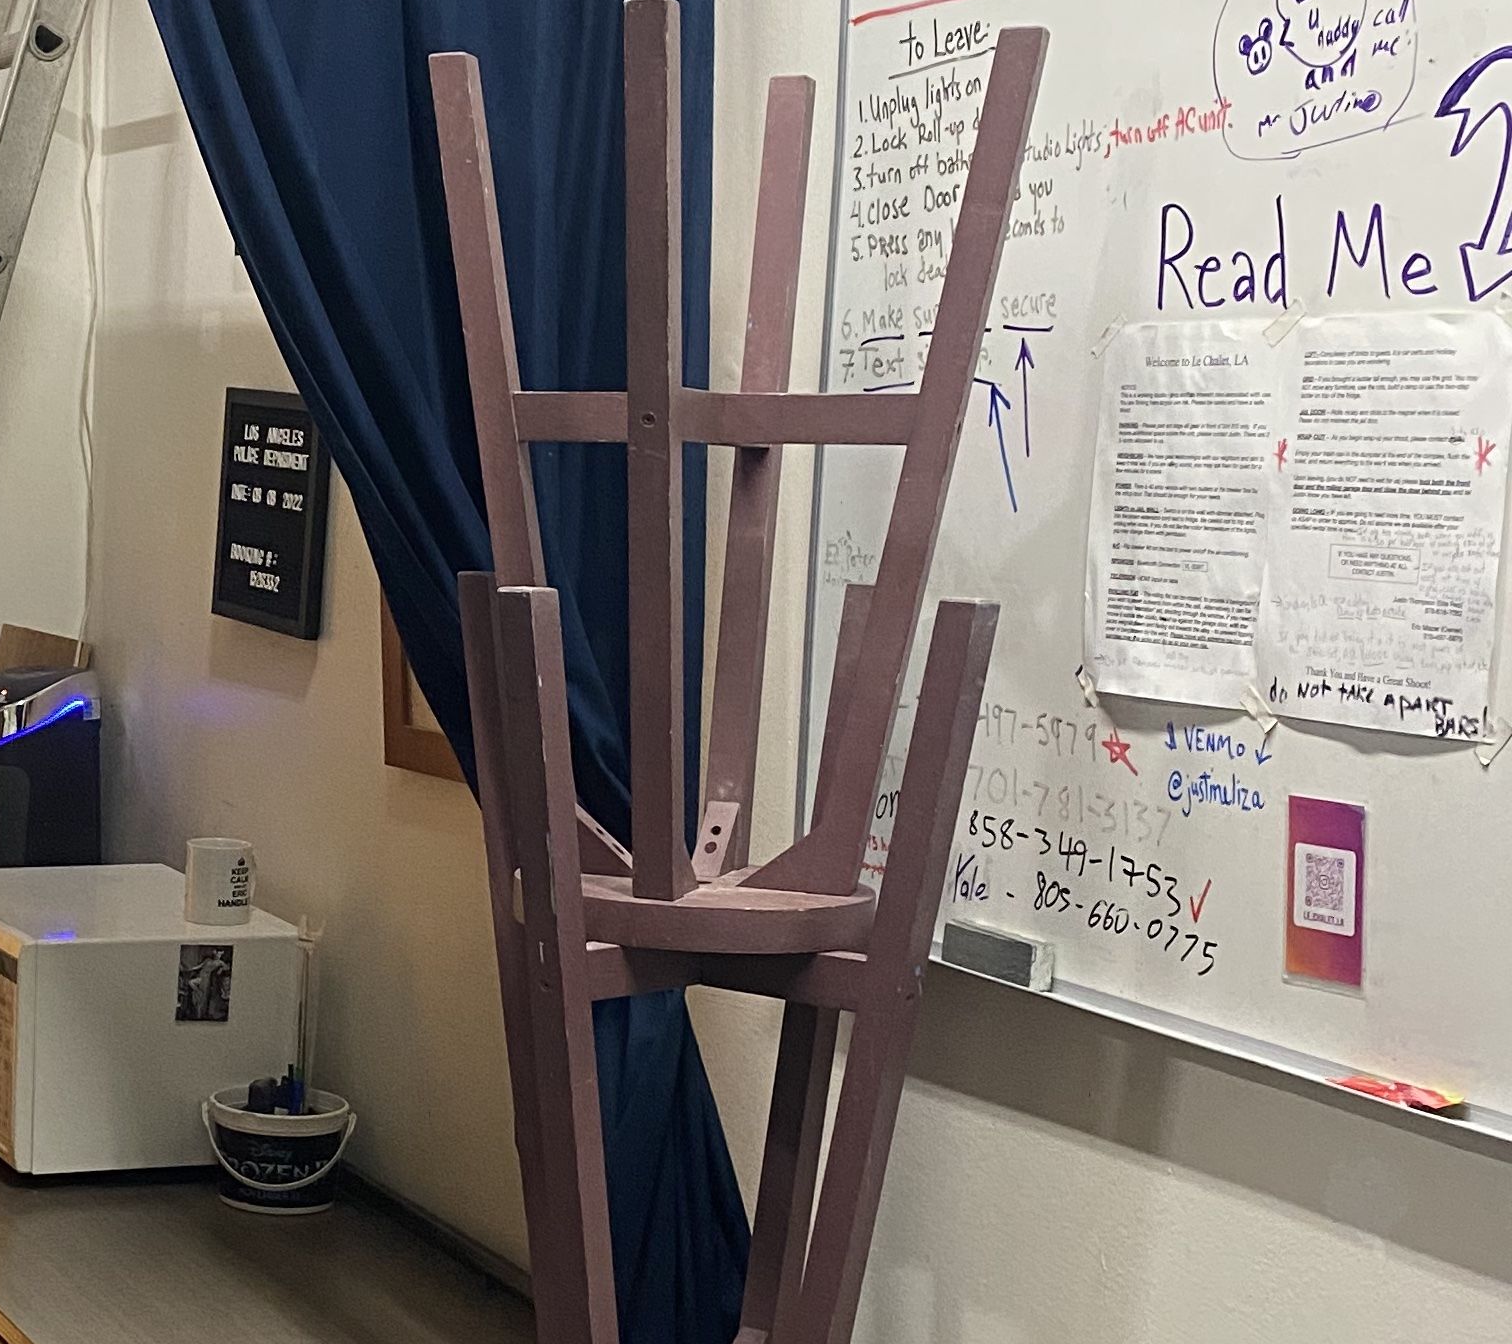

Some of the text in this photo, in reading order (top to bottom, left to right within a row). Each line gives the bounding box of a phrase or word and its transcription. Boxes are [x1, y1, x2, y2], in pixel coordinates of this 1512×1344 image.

[909, 153, 930, 180] off
[1029, 178, 1053, 215] you
[1157, 193, 1439, 311] Read Me
[1145, 355, 1180, 367] Welcome
[1191, 355, 1202, 367] Le
[1234, 353, 1249, 366] LA
[244, 423, 305, 448] LOS ANGELES
[1305, 665, 1327, 677] Thank
